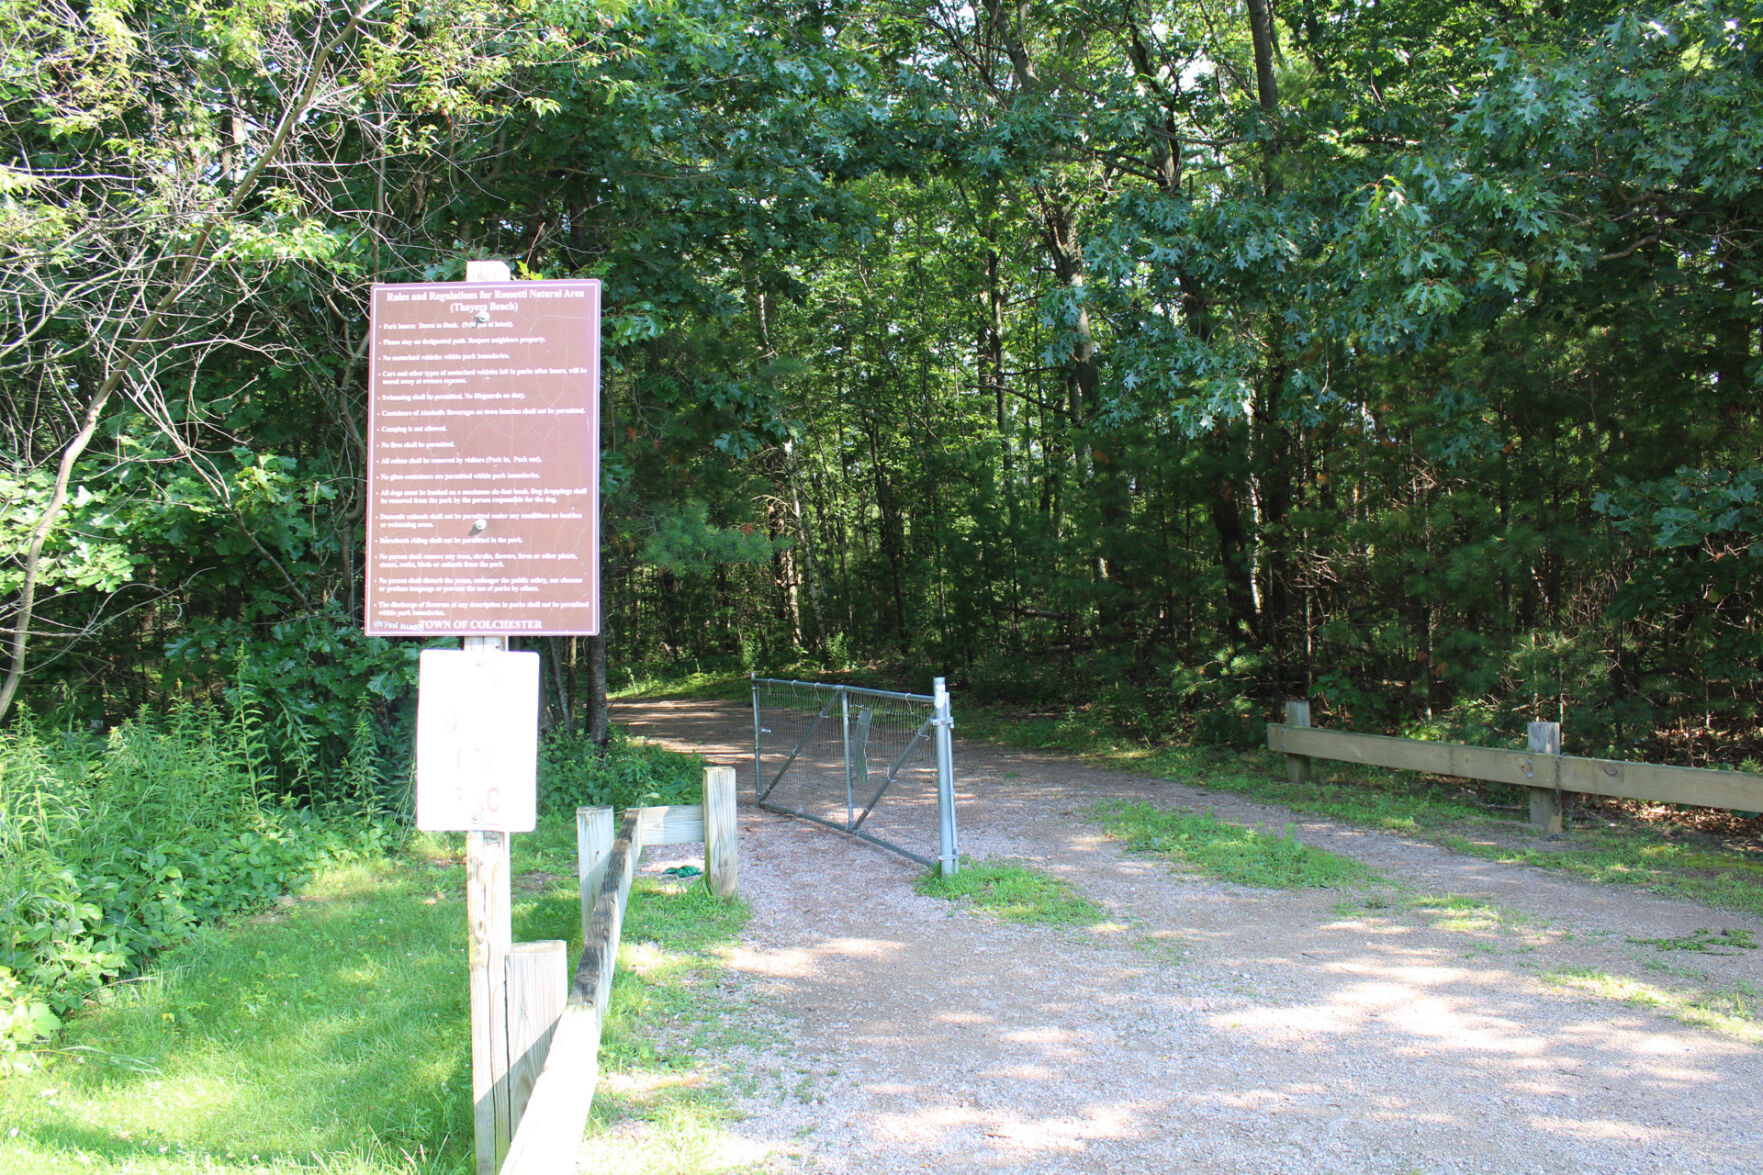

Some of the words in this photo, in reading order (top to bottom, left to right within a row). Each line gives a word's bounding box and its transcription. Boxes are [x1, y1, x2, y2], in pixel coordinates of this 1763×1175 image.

[386, 292, 410, 301] Rules
[411, 292, 427, 300] and
[429, 290, 477, 302] Regulations
[479, 290, 492, 298] for
[529, 289, 562, 298] Natural
[563, 289, 584, 297] Area
[489, 301, 518, 311] Beach)
[418, 620, 451, 628] TOWN
[453, 620, 468, 628] OF
[469, 620, 542, 628] COLCHESTER
